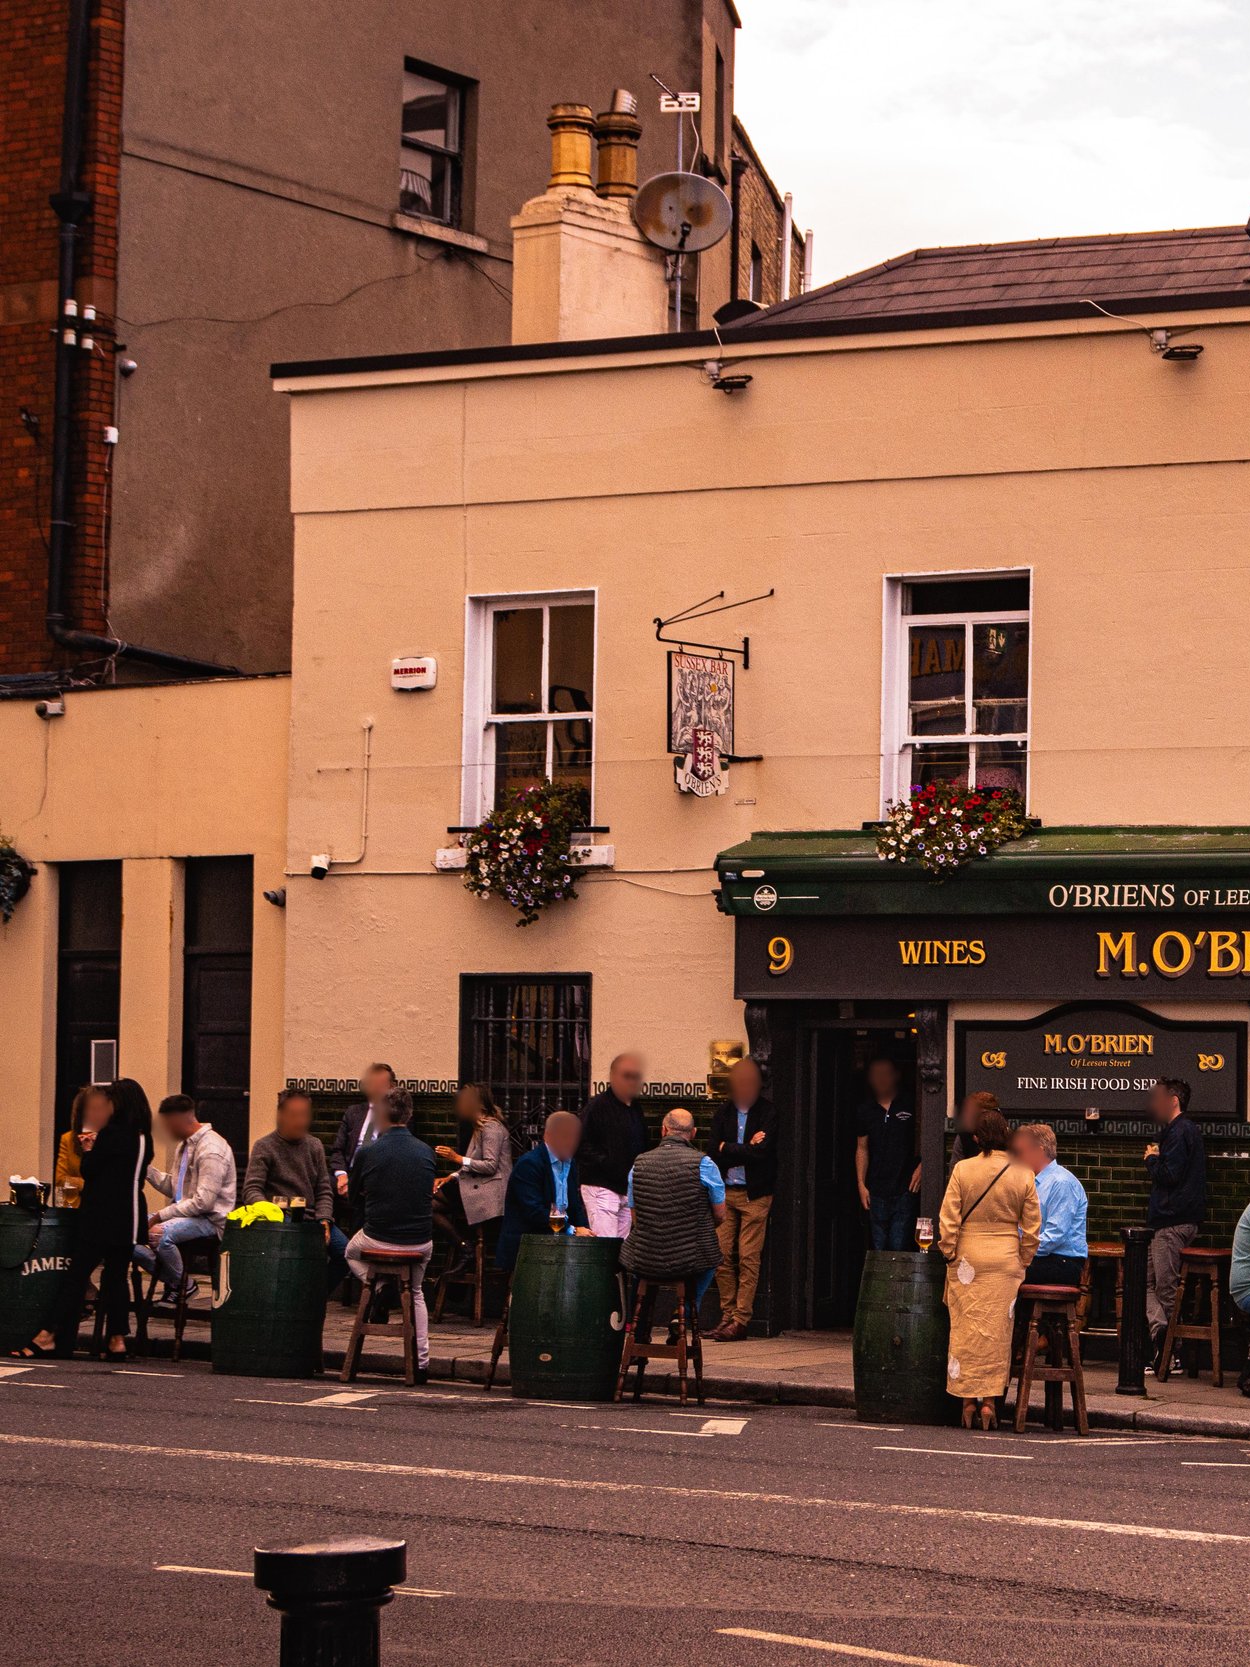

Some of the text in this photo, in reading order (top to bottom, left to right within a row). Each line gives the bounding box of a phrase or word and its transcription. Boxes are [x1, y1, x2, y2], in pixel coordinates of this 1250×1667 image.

[394, 667, 427, 675] MERRION
[674, 654, 728, 675] SUSSEX BAR
[1049, 884, 1175, 908] O'BRIENS
[1184, 889, 1210, 906] OF
[768, 936, 793, 973] 9
[898, 940, 987, 965] WINES
[1044, 1034, 1154, 1055] M.O'BRIEN
[1070, 1058, 1132, 1068] Of Leeson Street
[1017, 1077, 1160, 1092] FINE IRISH FOOD SER
[21, 1256, 73, 1276] JAMES
